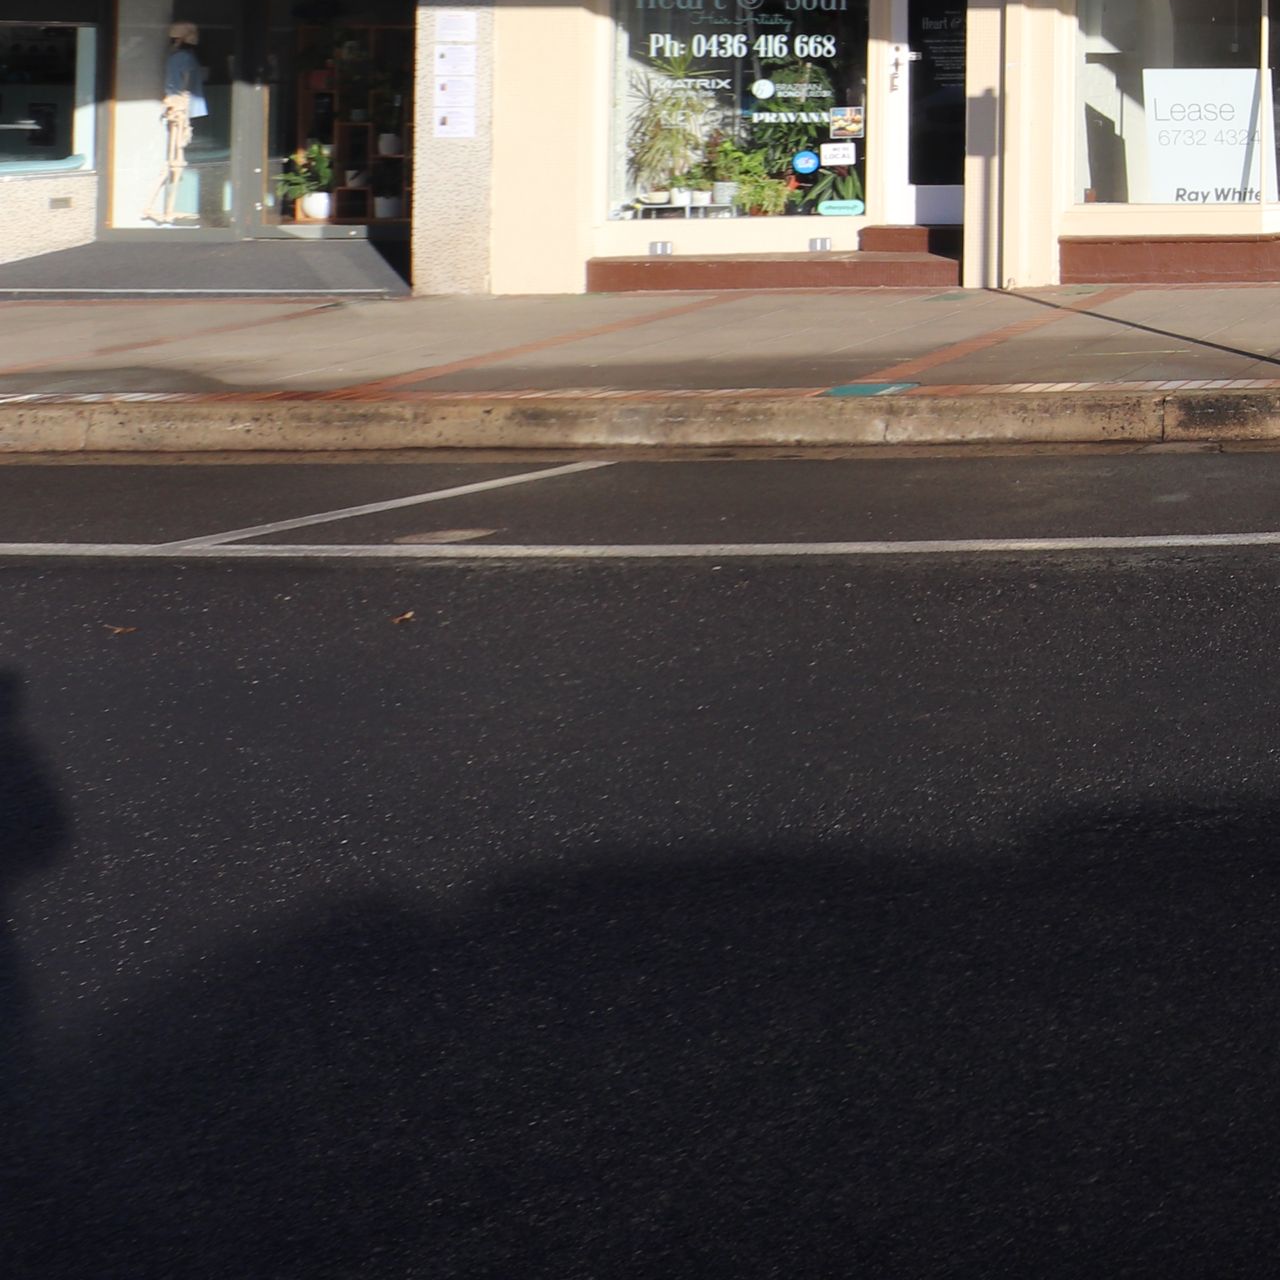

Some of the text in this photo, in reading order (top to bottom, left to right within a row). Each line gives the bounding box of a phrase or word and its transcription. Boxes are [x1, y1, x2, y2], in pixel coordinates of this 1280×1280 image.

[649, 33, 836, 58] Ph: 0436 416 668
[656, 79, 732, 89] MATRIX
[1154, 98, 1235, 121] Lease
[1158, 129, 1207, 146] 6732
[1175, 187, 1210, 203] Ray
